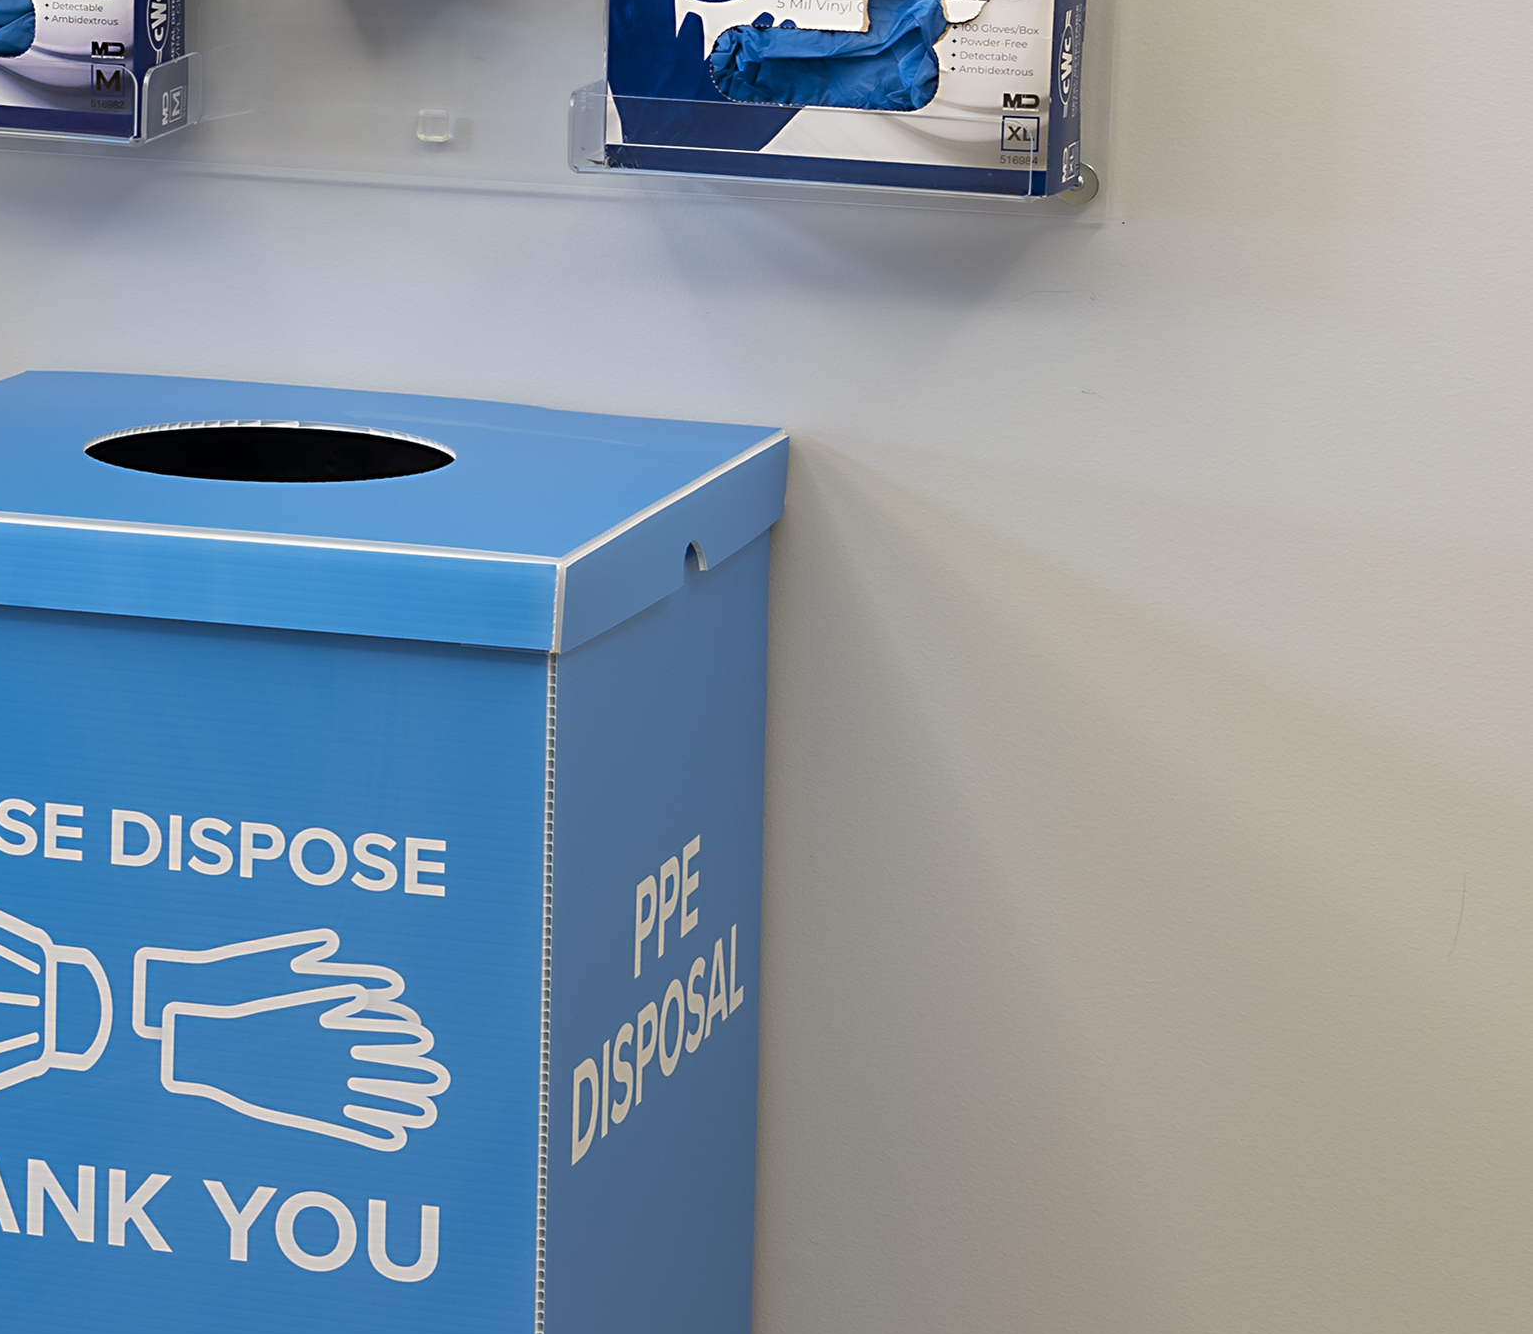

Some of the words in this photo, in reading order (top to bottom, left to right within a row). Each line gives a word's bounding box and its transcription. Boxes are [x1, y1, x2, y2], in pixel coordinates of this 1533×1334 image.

[52, 1, 104, 13] Detectable
[51, 15, 119, 26] Ambidextrous
[981, 24, 1040, 36] Gloves/Box
[91, 40, 126, 56] MD
[960, 37, 1028, 48] Powder-Free
[959, 51, 1018, 62] Detectable
[958, 65, 1034, 77] Ambidextrous
[95, 69, 121, 92] M
[90, 98, 125, 109] 516982
[1003, 93, 1040, 109] MD
[1007, 126, 1035, 142] XL
[999, 155, 1039, 166] 516984
[110, 809, 447, 897] DISPOSE
[634, 834, 701, 979] PPE
[571, 924, 744, 1167] DISPOSAL
[203, 1179, 440, 1283] YOU
